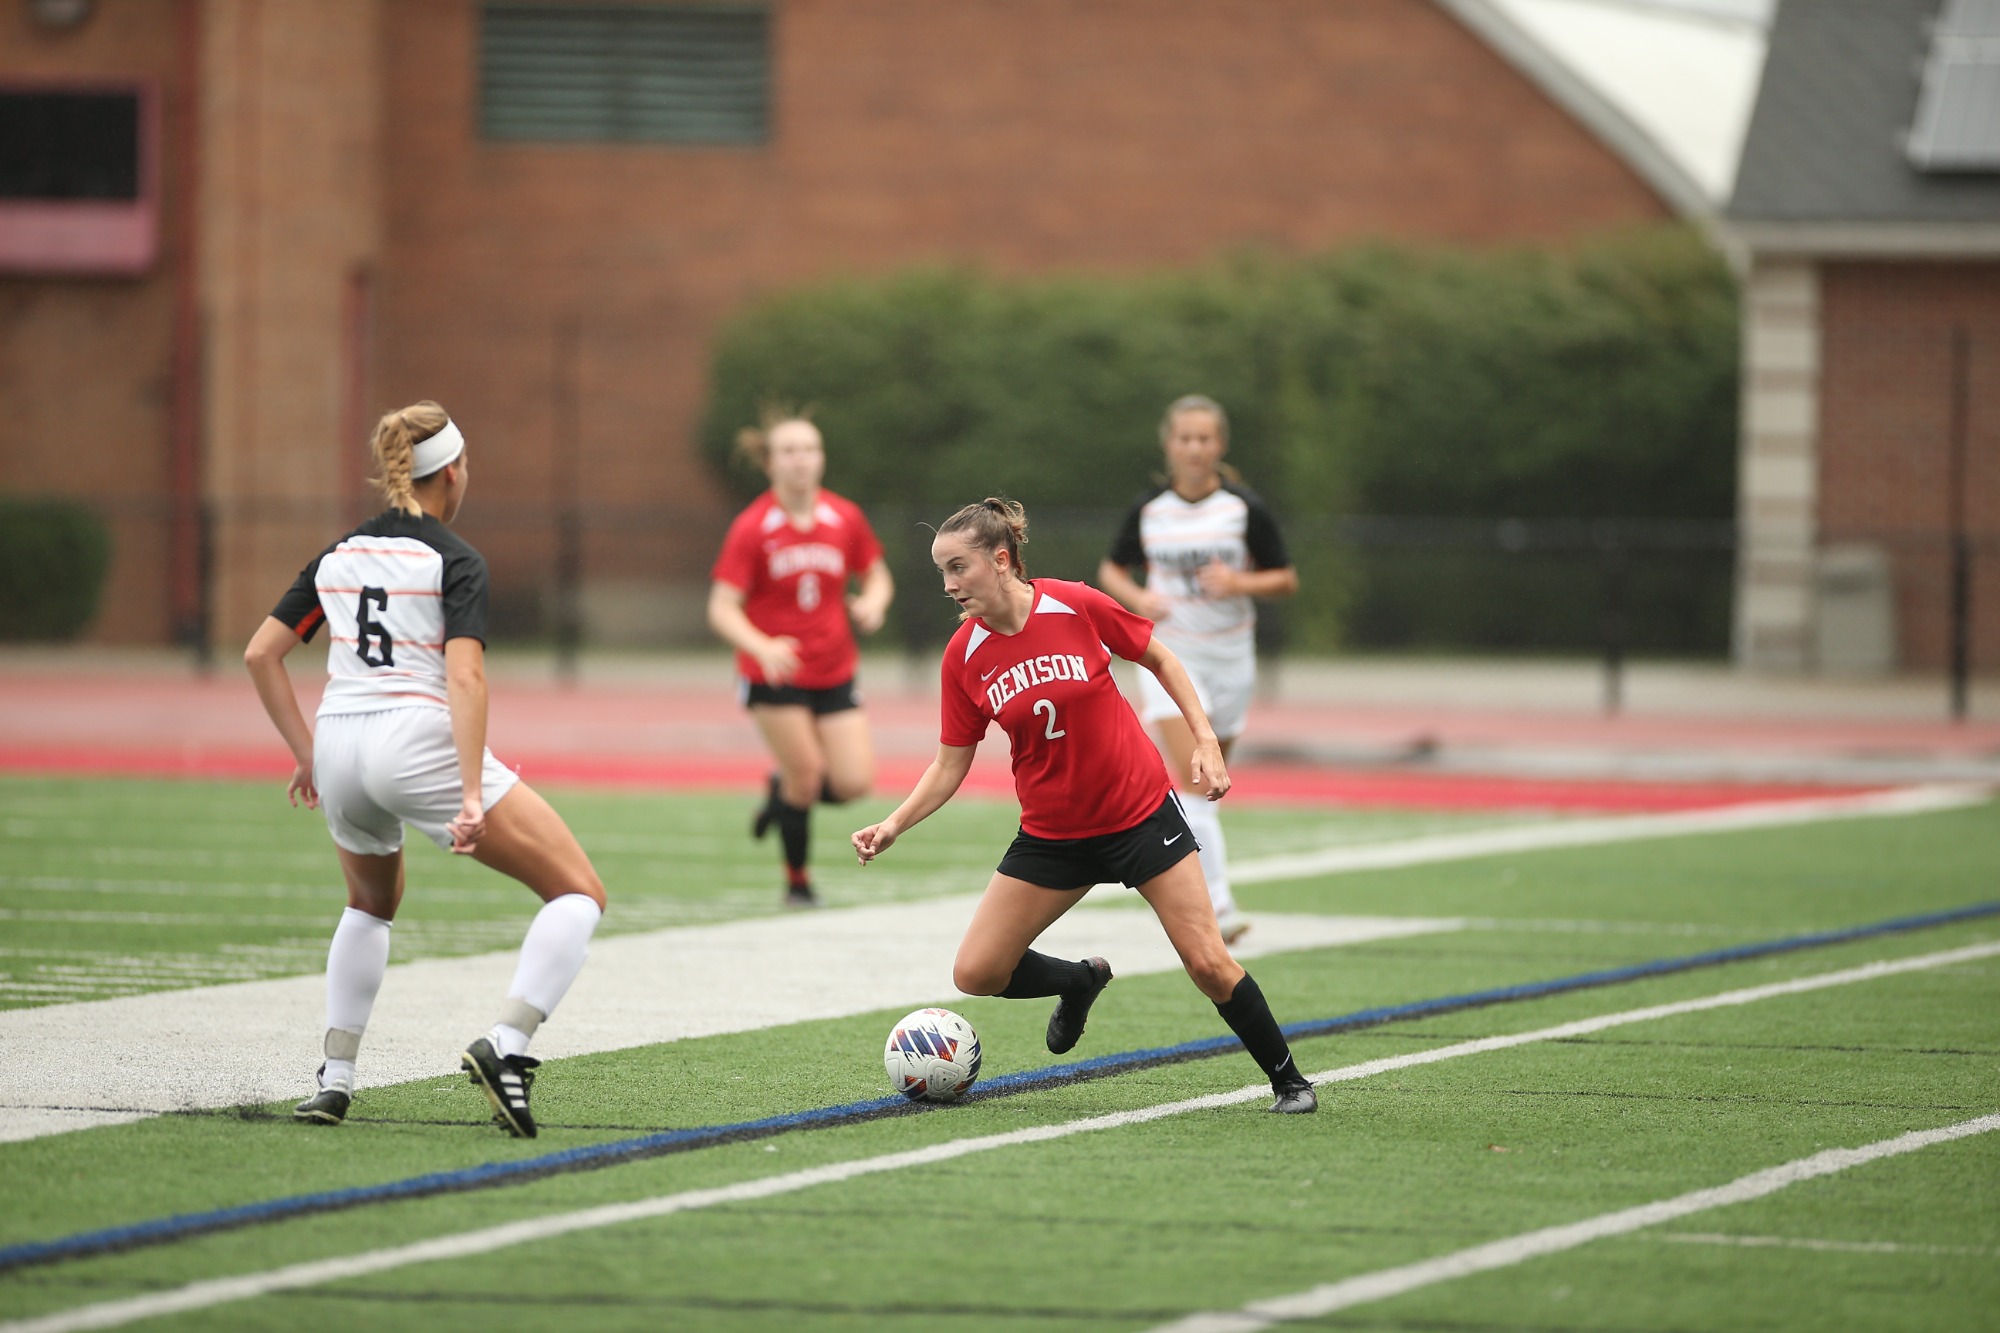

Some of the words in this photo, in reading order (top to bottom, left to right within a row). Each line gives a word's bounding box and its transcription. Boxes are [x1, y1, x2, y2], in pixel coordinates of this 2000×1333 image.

[356, 585, 394, 668] 6
[986, 654, 1089, 716] DENISON
[1032, 698, 1066, 740] 2
